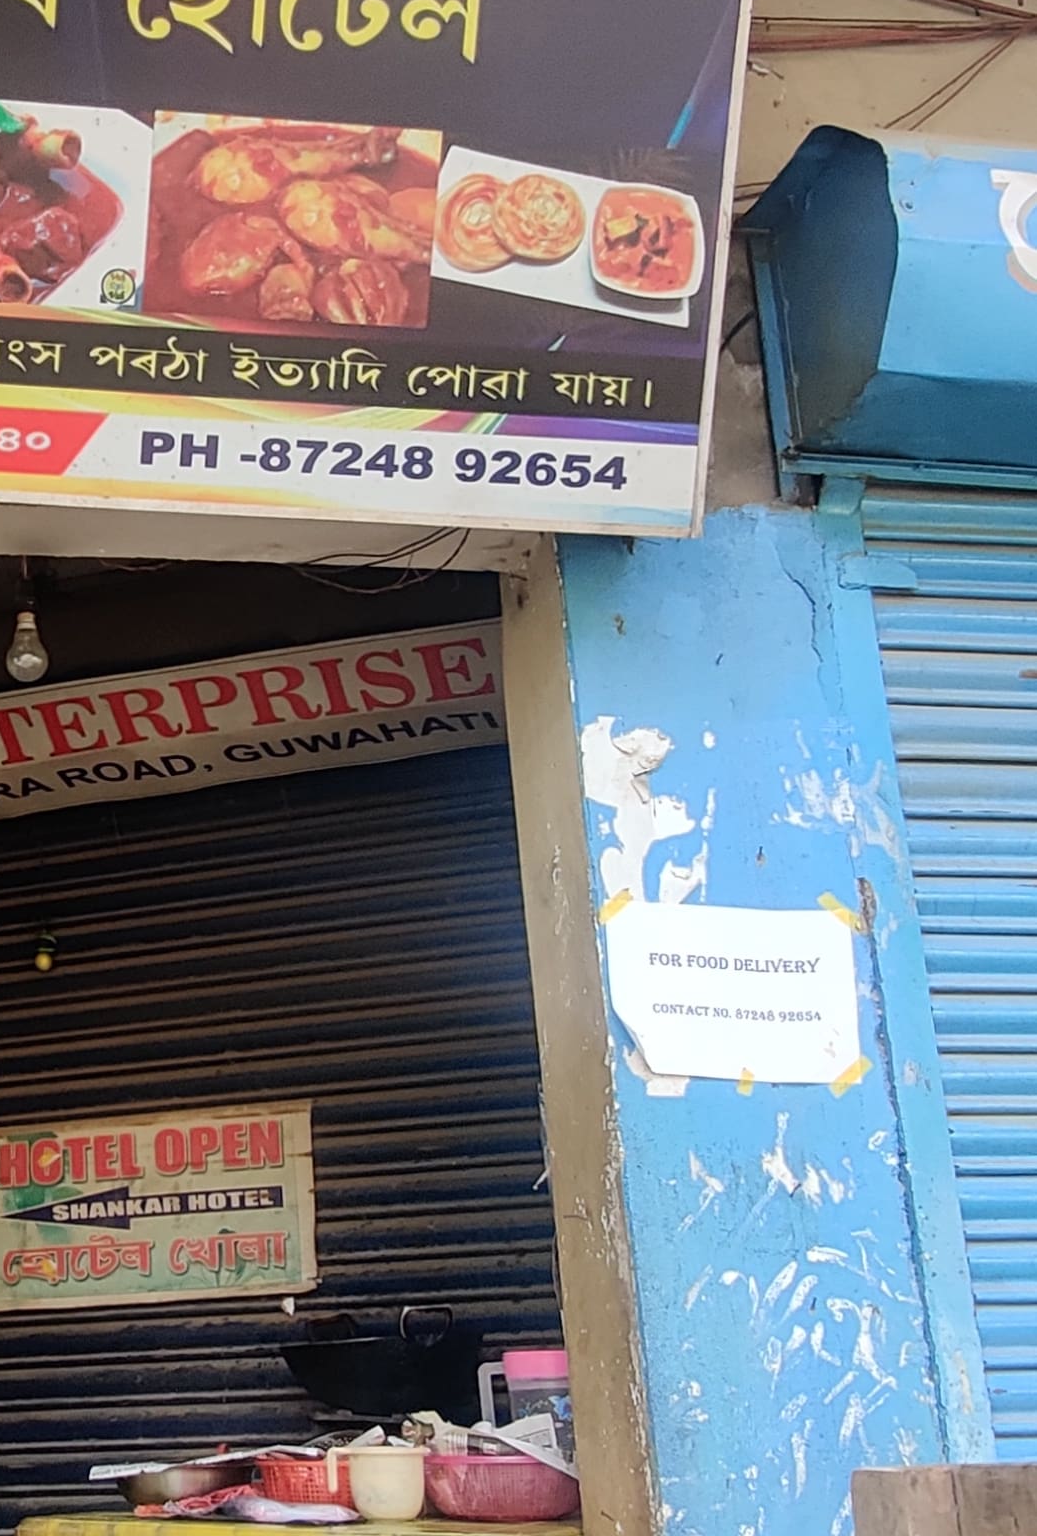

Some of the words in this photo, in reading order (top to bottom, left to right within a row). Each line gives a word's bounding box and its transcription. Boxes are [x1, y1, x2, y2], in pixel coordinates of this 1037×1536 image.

[89, 336, 209, 383] পৰঠা
[230, 342, 388, 393] ইত্যাদি
[407, 360, 530, 403] পোৱা
[140, 430, 220, 470] PH
[239, 439, 434, 481] -87248
[454, 448, 628, 491] 92654
[59, 754, 214, 789] ROAD,
[222, 710, 501, 766] GUWAHATI
[649, 952, 682, 968] FOR
[686, 954, 729, 971] FOOD
[733, 957, 820, 975] DELIVERY
[652, 1002, 710, 1017] CONTACT
[713, 1007, 732, 1019] NO.
[735, 1008, 776, 1022] 87248
[778, 1010, 822, 1023] 92654
[154, 1120, 284, 1176] OPEN
[51, 1196, 182, 1222] SHANKAR
[188, 1189, 274, 1212] HOTEL
[2, 1234, 155, 1286] হোটেল
[169, 1231, 290, 1276] খোলা
